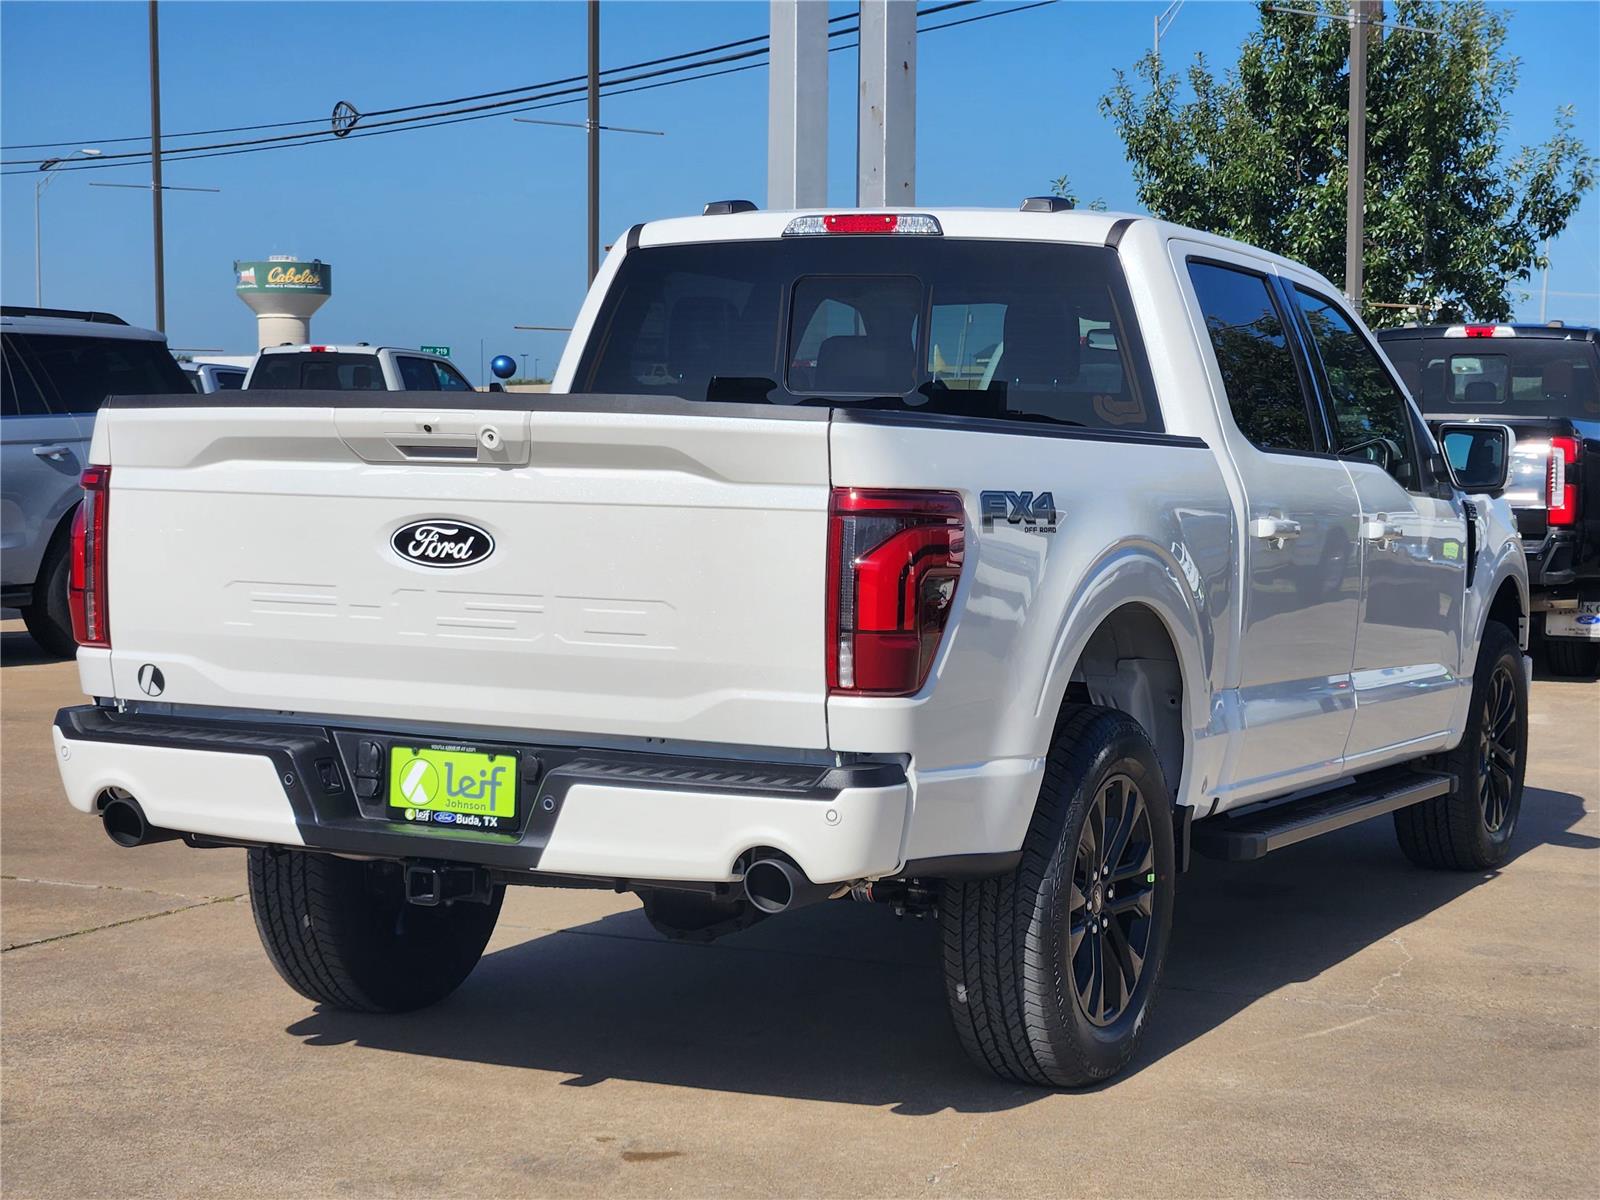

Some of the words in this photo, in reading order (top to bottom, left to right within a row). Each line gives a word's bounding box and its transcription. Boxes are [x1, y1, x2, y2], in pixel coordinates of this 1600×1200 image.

[980, 490, 1056, 527] FX4
[1039, 526, 1057, 534] ROAD
[407, 526, 475, 559] Ford
[444, 762, 506, 812] leif
[445, 799, 486, 811] Johnson
[456, 814, 481, 827] Buda,
[483, 816, 498, 827] TX
